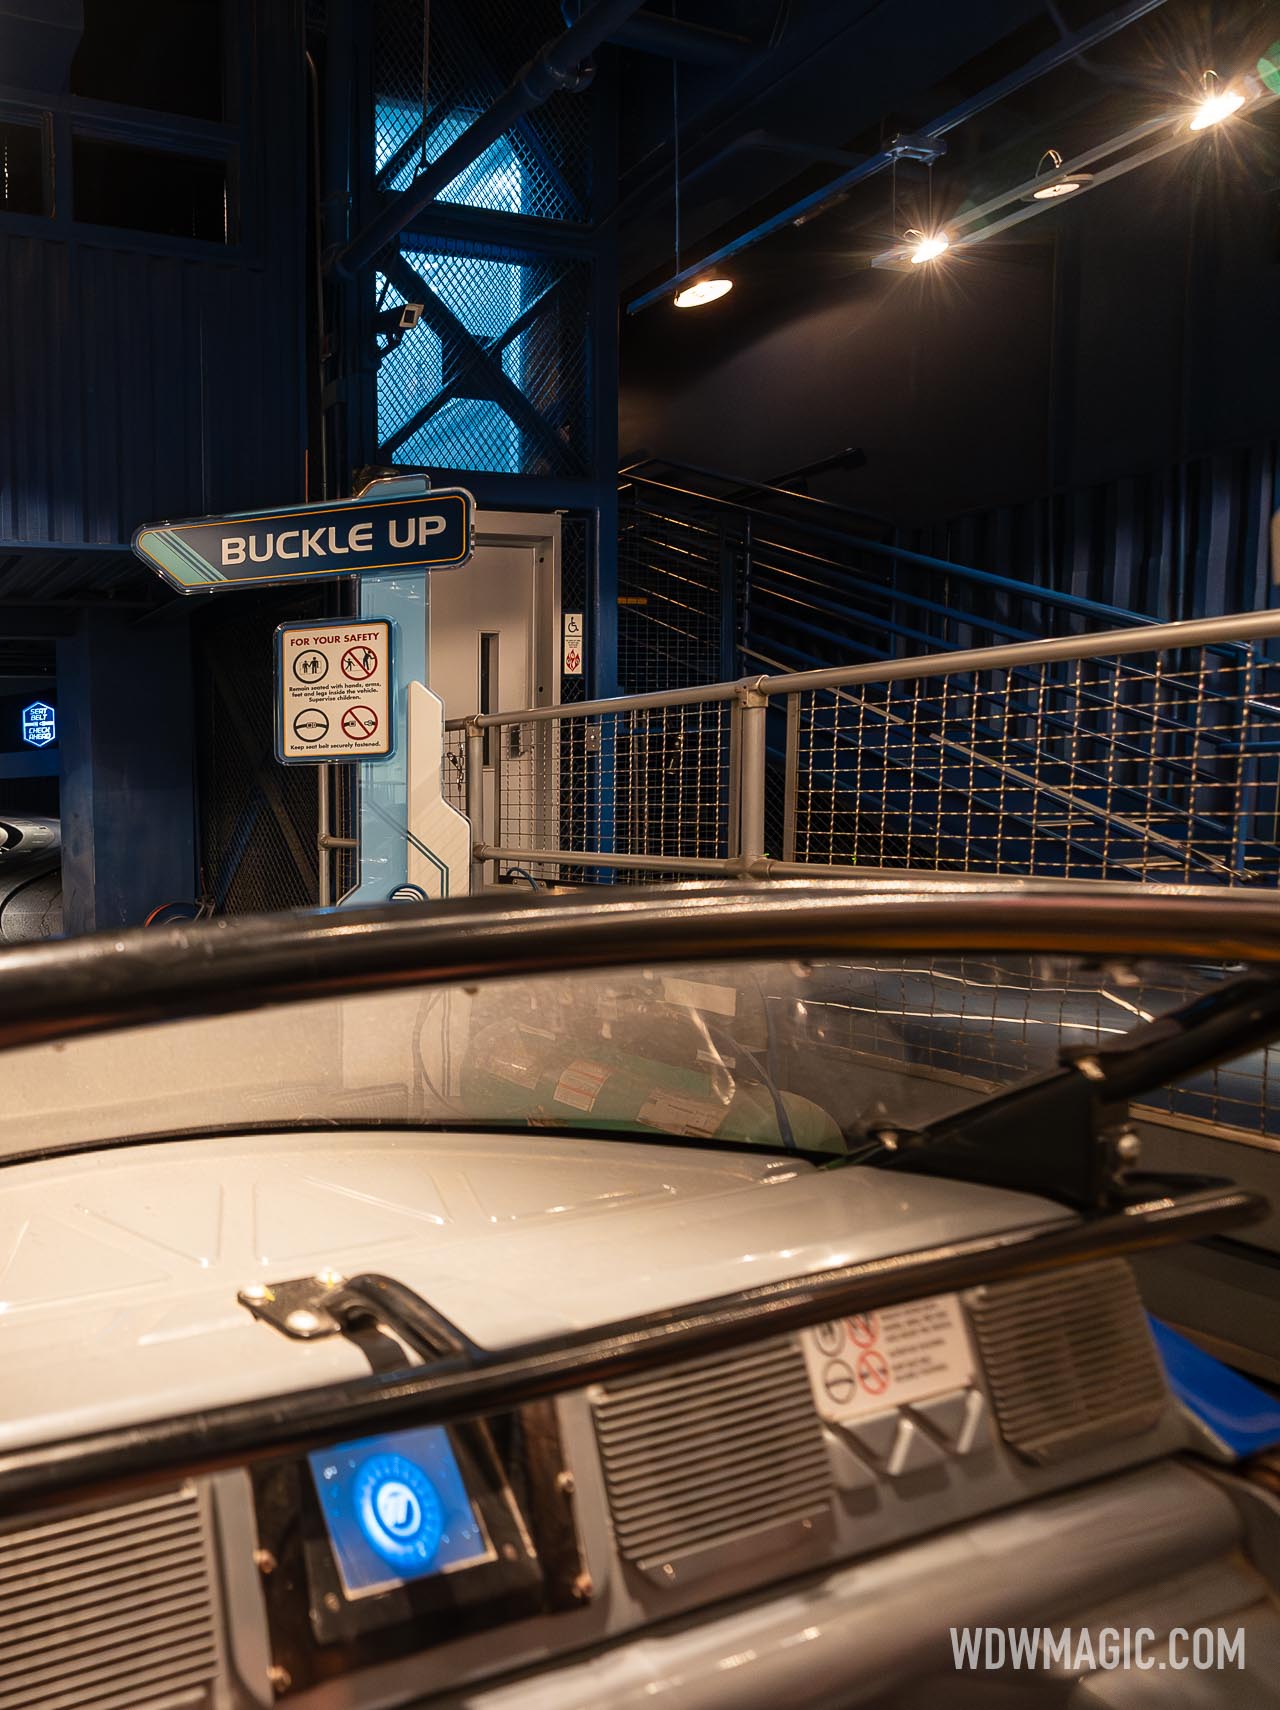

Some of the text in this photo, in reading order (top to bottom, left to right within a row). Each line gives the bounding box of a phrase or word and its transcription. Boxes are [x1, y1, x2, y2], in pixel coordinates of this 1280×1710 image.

[221, 515, 447, 566] BUCKLE UP
[290, 632, 379, 647] FOR YOUR SAFETY
